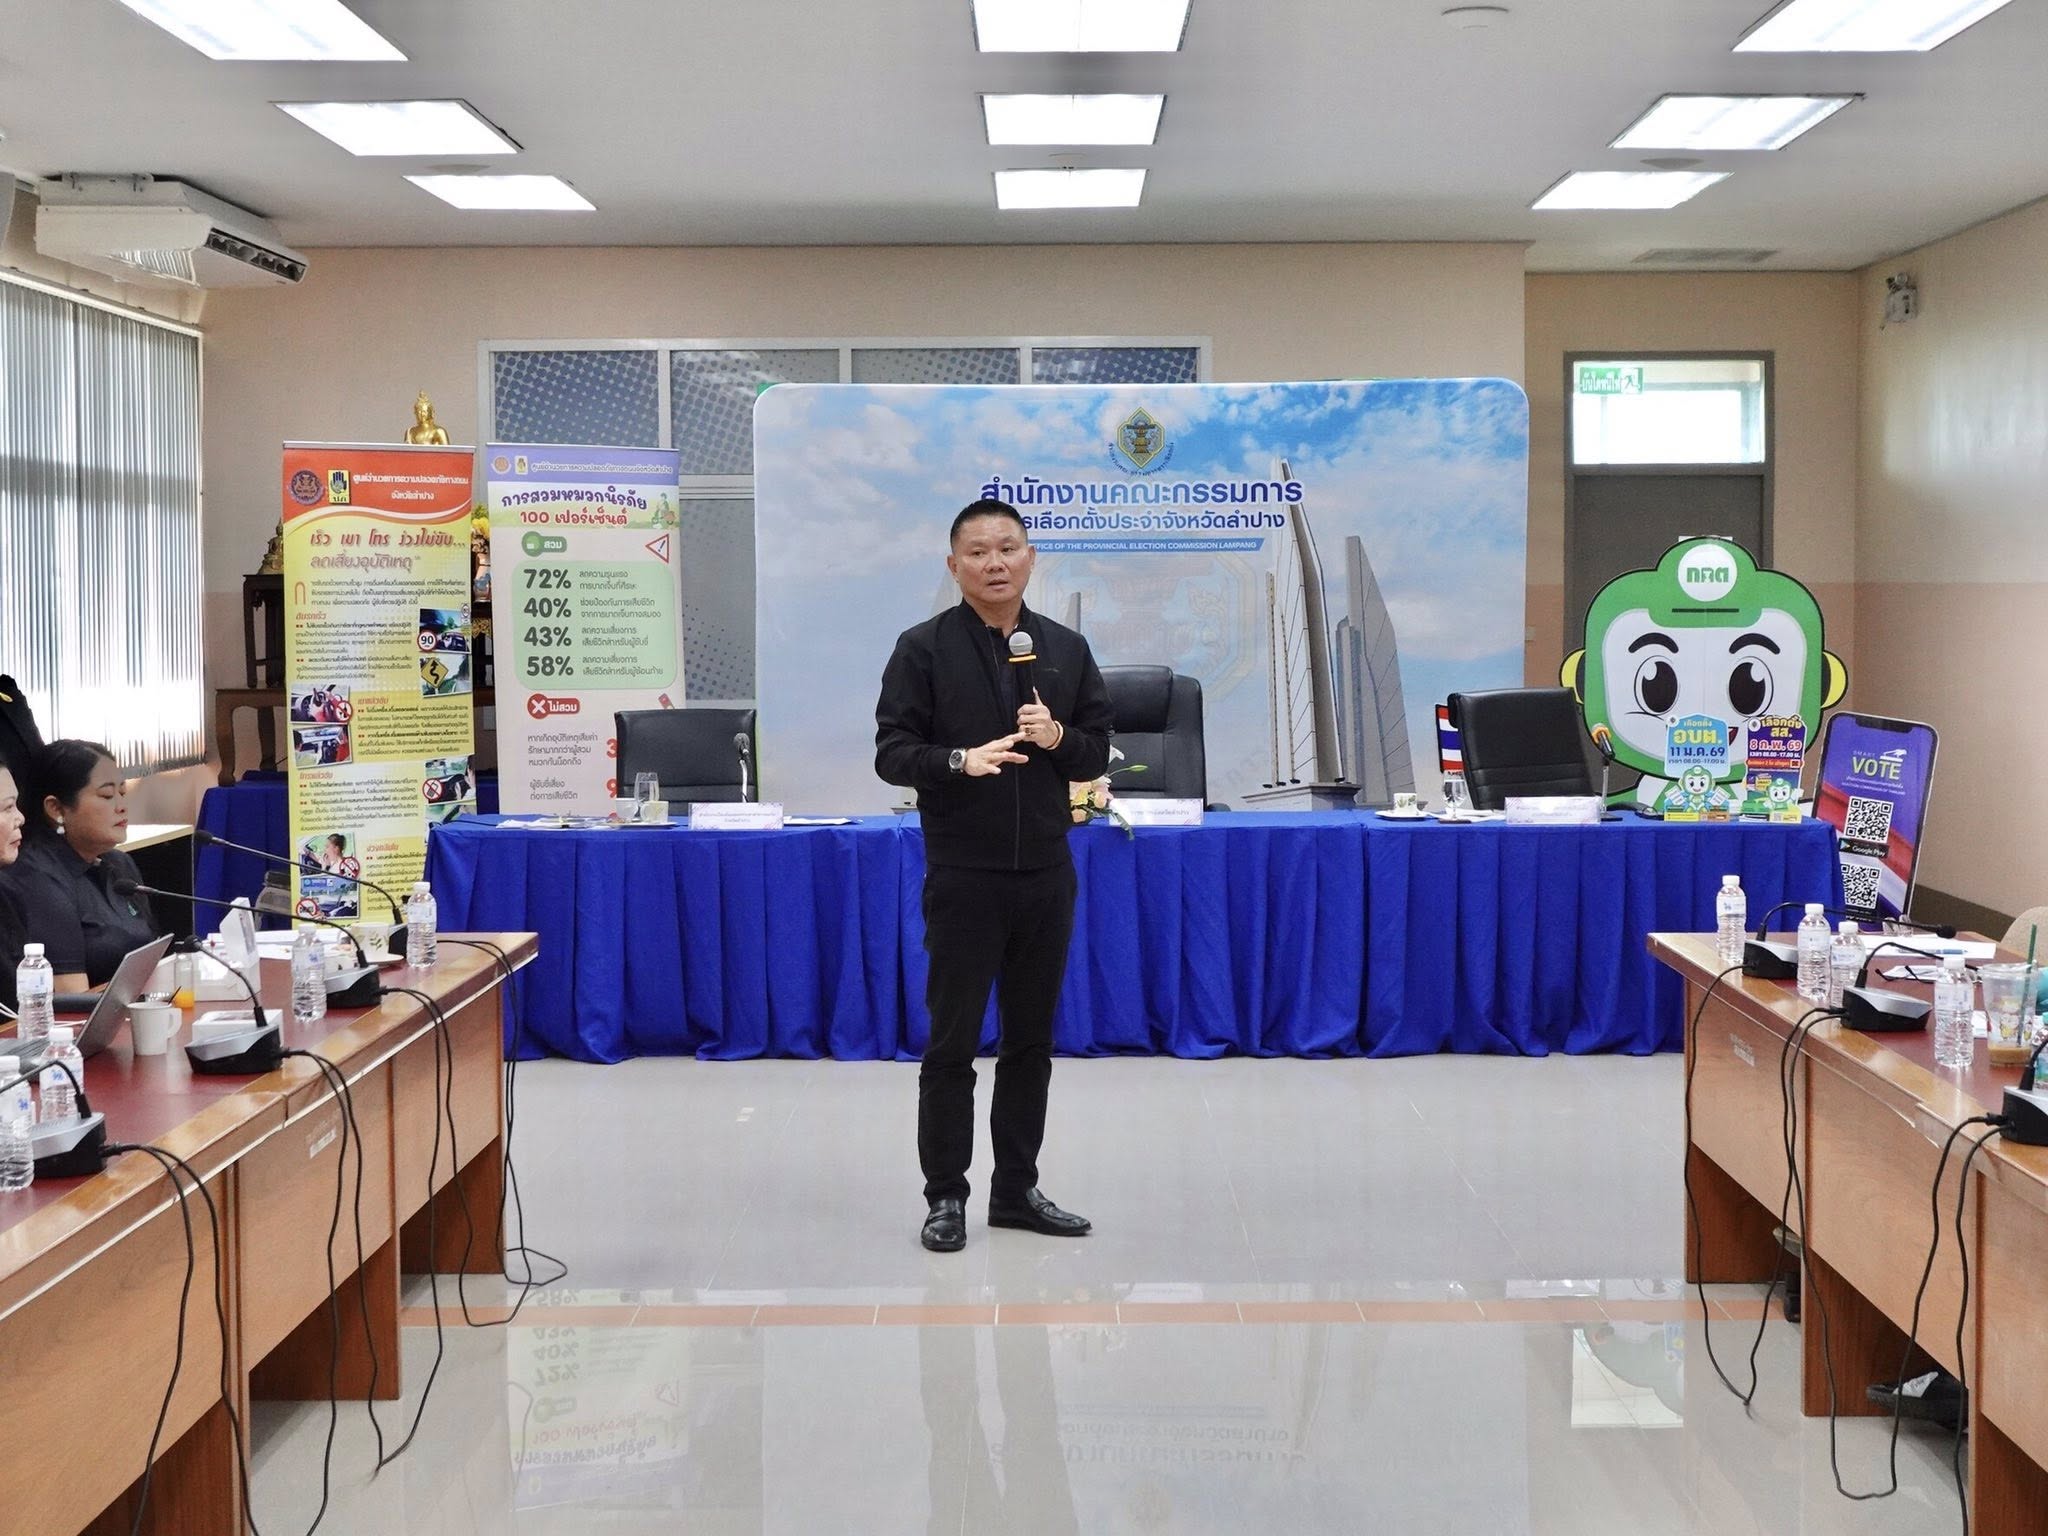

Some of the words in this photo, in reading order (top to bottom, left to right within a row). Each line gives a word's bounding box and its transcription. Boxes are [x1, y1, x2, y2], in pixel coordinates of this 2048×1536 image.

[501, 485, 648, 511] การสวมหมวกนิรภัย
[981, 476, 1303, 505] สำนักงานคณะกรรมการ
[520, 511, 550, 524] 100
[555, 507, 628, 525] เปอร์เซ็นต์
[1021, 507, 1285, 530] รเลือกตั้งประจำจังหวัดลำปาง
[310, 529, 331, 546] เร็ว
[341, 534, 360, 545] เมา
[368, 529, 390, 546] โทร
[543, 541, 563, 549] สวม
[1036, 542, 1054, 550] FICE
[1055, 542, 1065, 550] OF
[1066, 542, 1082, 550] THE
[1083, 542, 1128, 550] PROVINCIAL
[1129, 542, 1166, 550] ELECTION
[1168, 542, 1218, 550] COMMISSION
[1219, 541, 1257, 549] LAMPANG
[523, 569, 571, 589] 72%
[523, 598, 572, 618] 40%
[420, 635, 434, 645] 90
[523, 627, 572, 647] 43%
[526, 656, 574, 676] 58%
[547, 700, 578, 712] ไม่สวม
[1761, 715, 1802, 729] เลือกตั้ง
[1673, 729, 1723, 745] อบต.
[1770, 727, 1793, 738] สส.
[1670, 746, 1681, 757] 11
[1683, 747, 1709, 757] ม.ค.
[1710, 746, 1726, 757] 69
[1750, 739, 1758, 750] 8
[1759, 740, 1786, 751] ก.พ.
[1787, 740, 1803, 752] 69
[1852, 756, 1902, 780] VOTE
[1852, 845, 1874, 855] Google
[1873, 849, 1886, 857] Play
